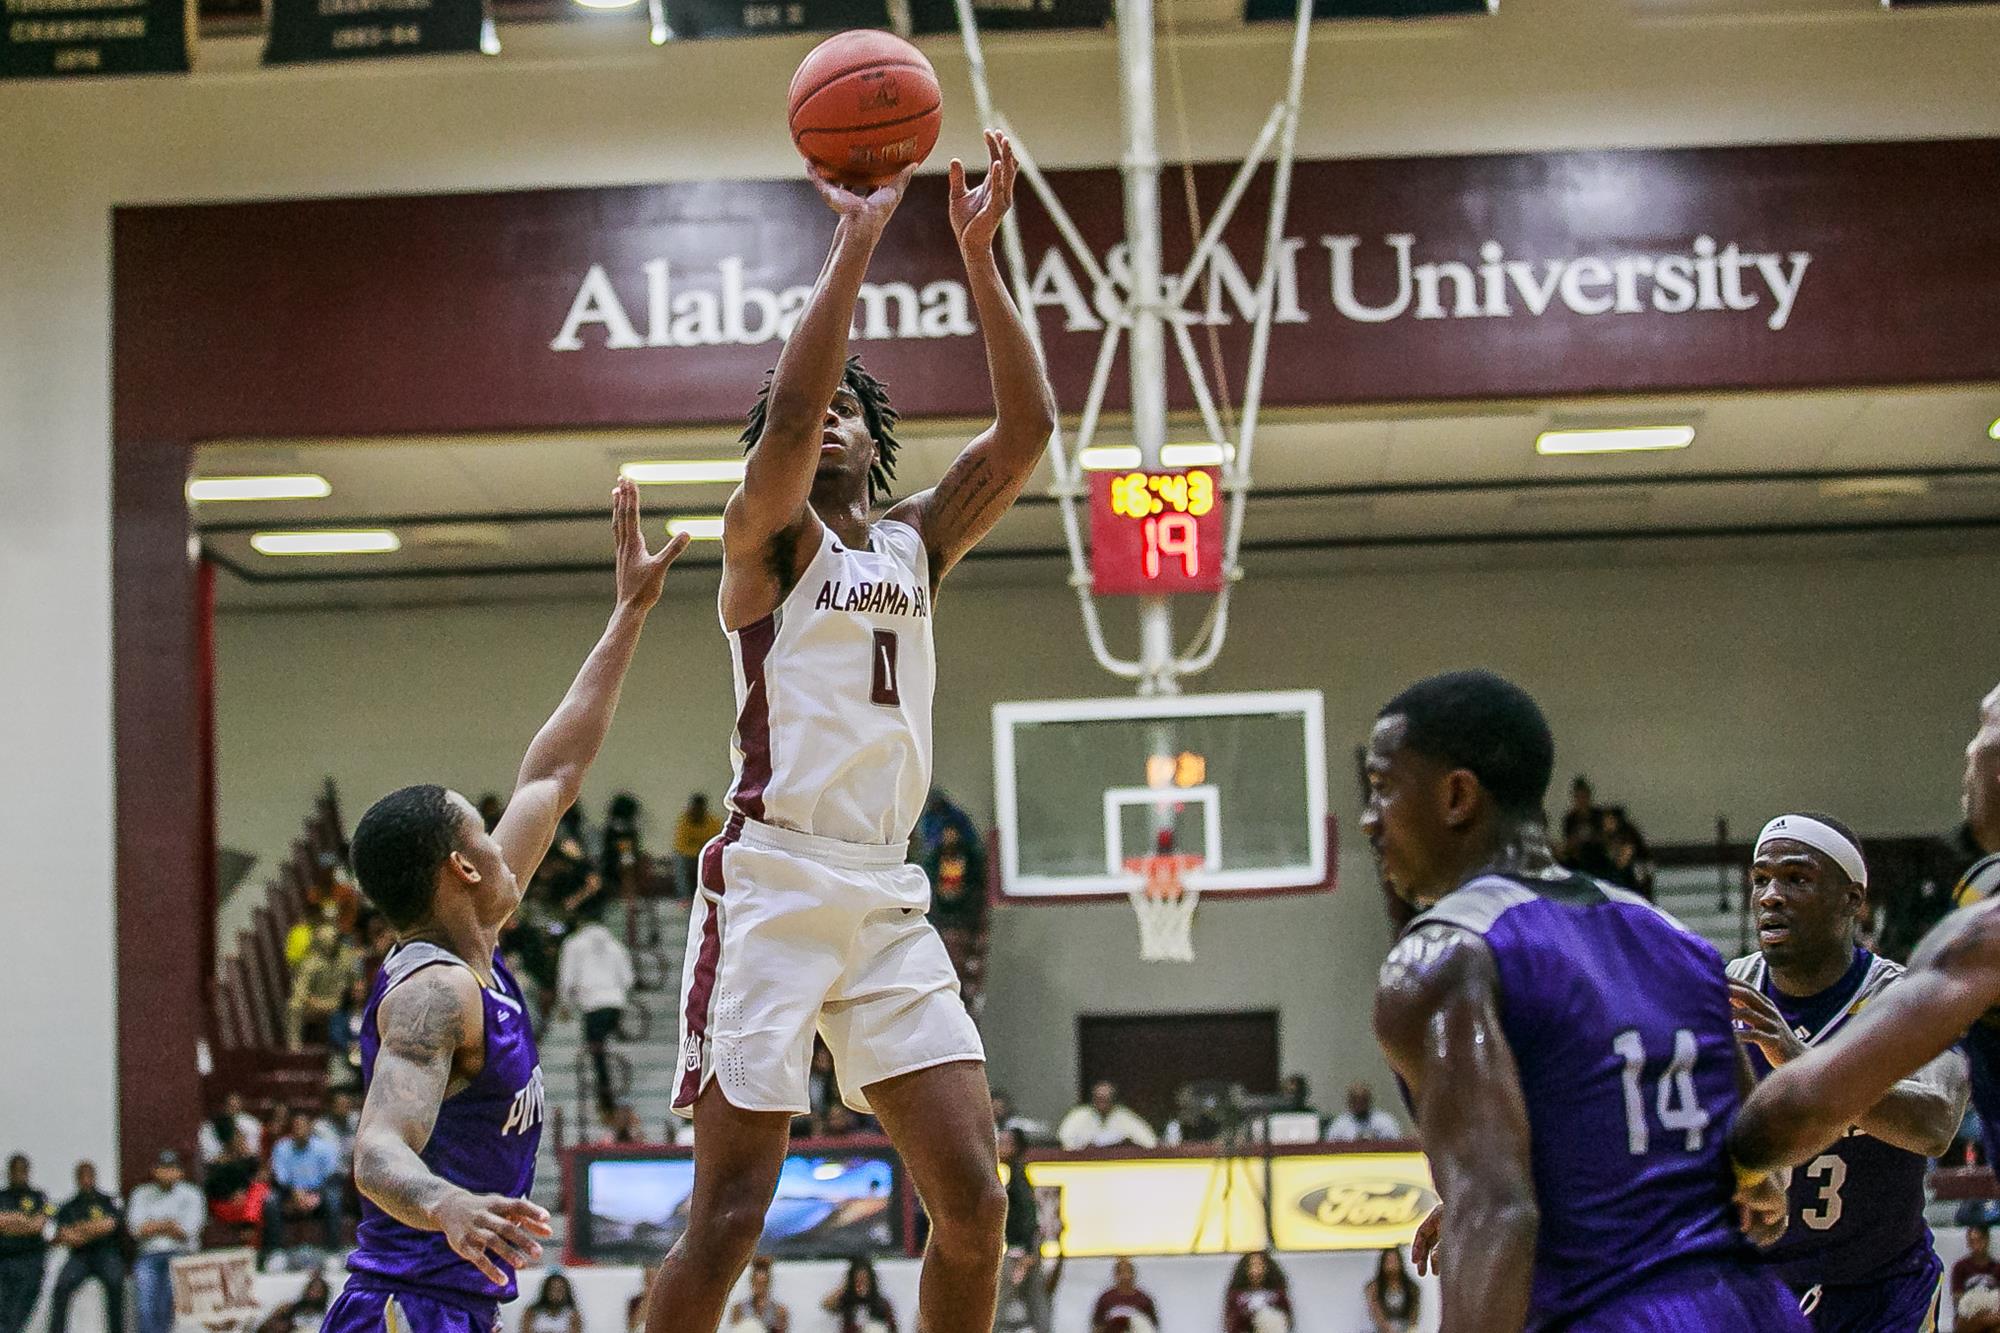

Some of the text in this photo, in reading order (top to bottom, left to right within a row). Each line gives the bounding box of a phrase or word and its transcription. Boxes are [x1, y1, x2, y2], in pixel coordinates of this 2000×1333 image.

[1321, 233, 1811, 330] University
[1141, 512, 1198, 579] 19
[815, 580, 908, 616] ALABAMA
[1613, 1029, 1709, 1155] 14
[1317, 1183, 1422, 1226] Ford
[1767, 1154, 1847, 1230] 3
